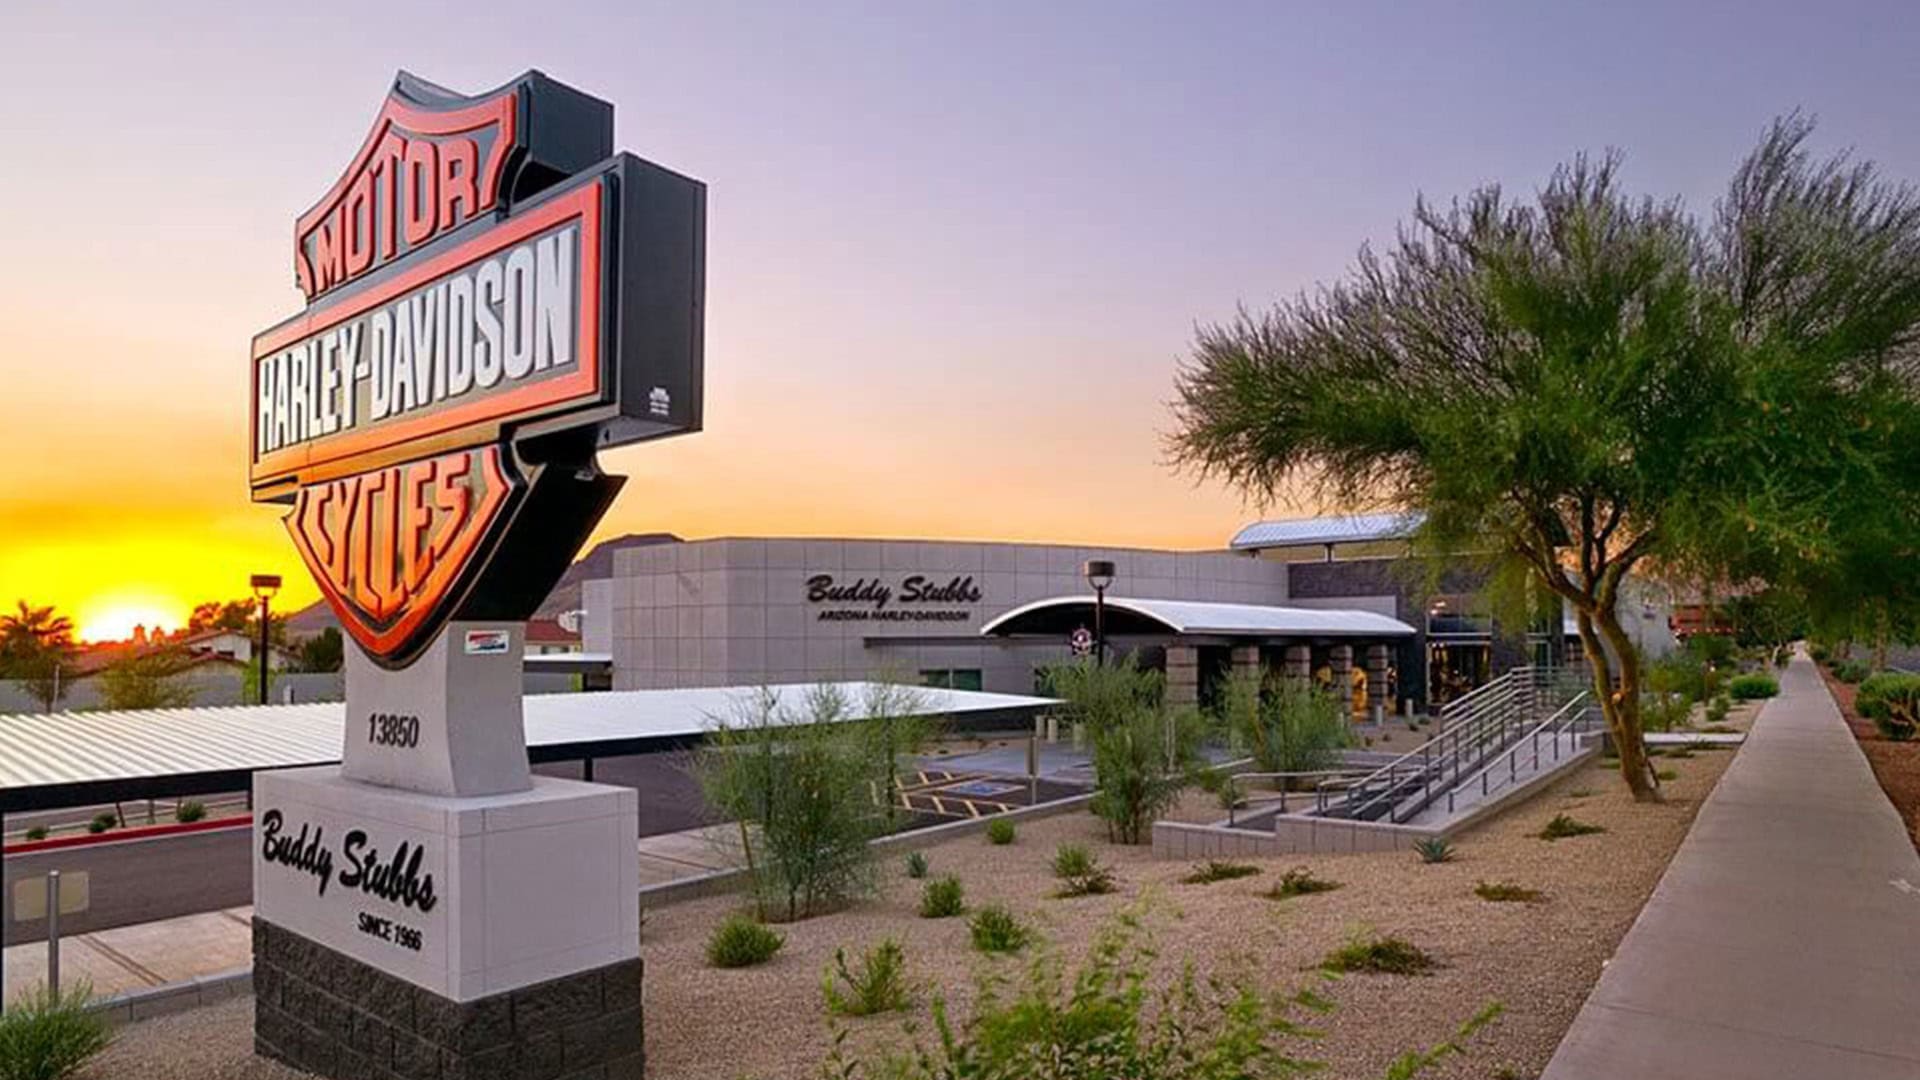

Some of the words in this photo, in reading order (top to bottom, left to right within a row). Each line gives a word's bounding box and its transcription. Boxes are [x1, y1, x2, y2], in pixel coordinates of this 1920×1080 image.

[316, 128, 481, 292] MOTOR
[257, 228, 578, 456] HARLEY-DAVIDSON
[303, 453, 472, 618] CYCLES
[806, 574, 891, 609] Buddy
[899, 575, 982, 602] Stubbs
[818, 610, 869, 622] ARIZONA
[368, 712, 420, 749] 13850
[262, 809, 333, 897] Buddy
[339, 830, 437, 912] Stubbs
[358, 911, 392, 941] SINCE
[395, 925, 423, 951] 1966
